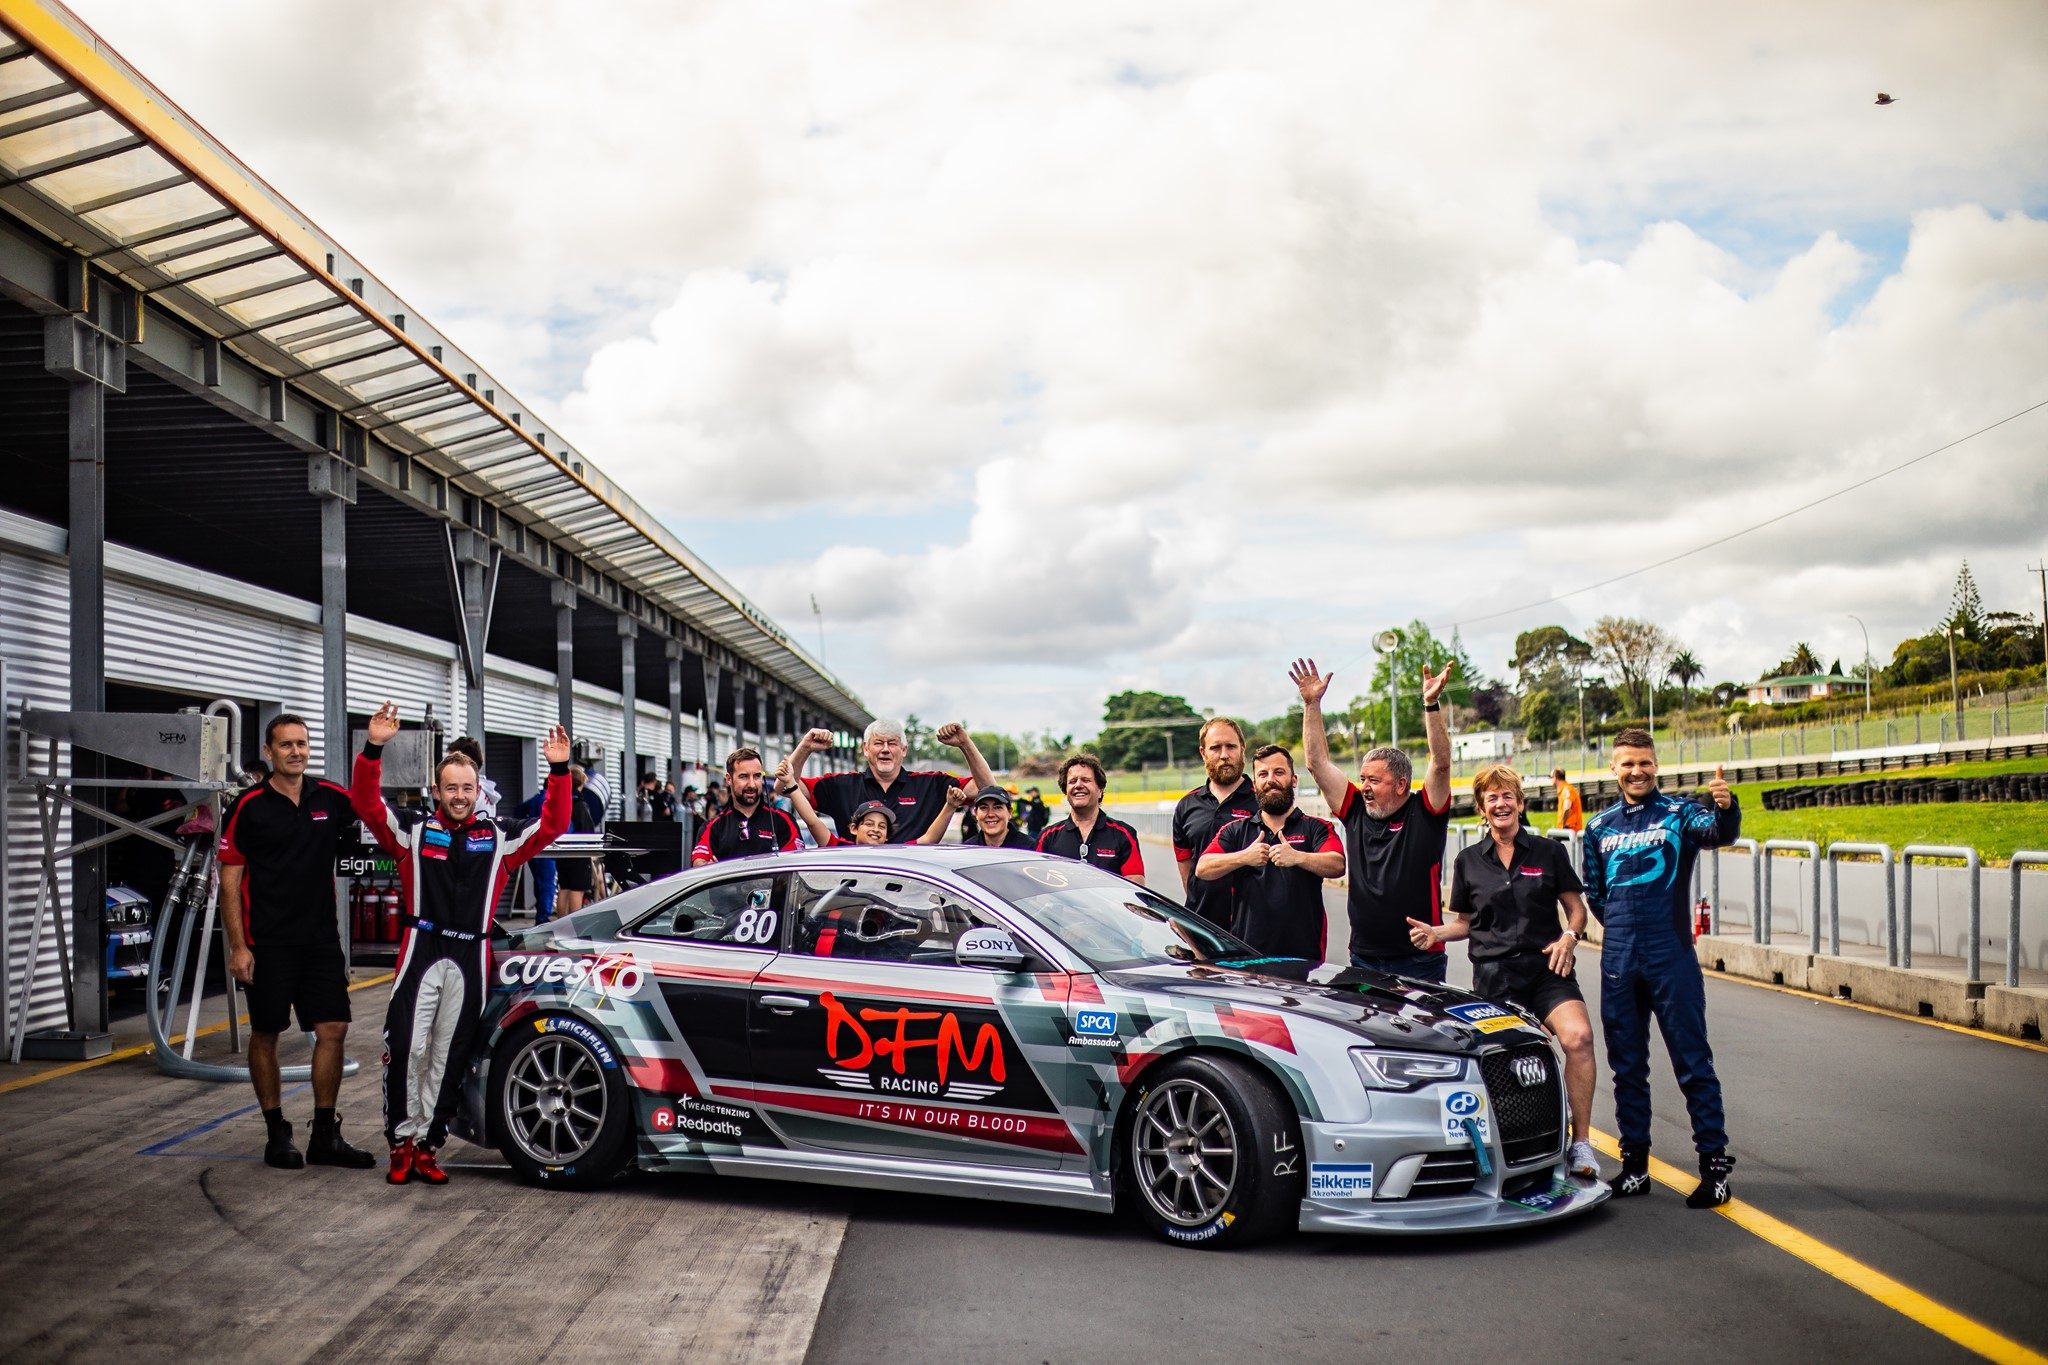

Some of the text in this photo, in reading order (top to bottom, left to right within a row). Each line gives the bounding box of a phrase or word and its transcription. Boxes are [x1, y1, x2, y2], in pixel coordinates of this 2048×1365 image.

[340, 856, 397, 876] signwi
[734, 909, 778, 944] 80
[965, 939, 1014, 952] SONY
[1080, 1015, 1112, 1030] SPCA
[557, 1020, 613, 1065] MICHELIN
[819, 991, 1007, 1086] DFM
[1068, 1036, 1121, 1048] Ambassador
[880, 1077, 939, 1094] RACING
[716, 1106, 750, 1119] TENZING
[859, 1103, 1027, 1133] IT'S IN OUR BLOOD
[677, 1115, 742, 1136] Redpaths
[1273, 1131, 1299, 1177] RF
[1311, 1175, 1371, 1189] sikkens
[1311, 1190, 1353, 1198] AkzoNobel
[1168, 1227, 1218, 1242] MICHELIN
